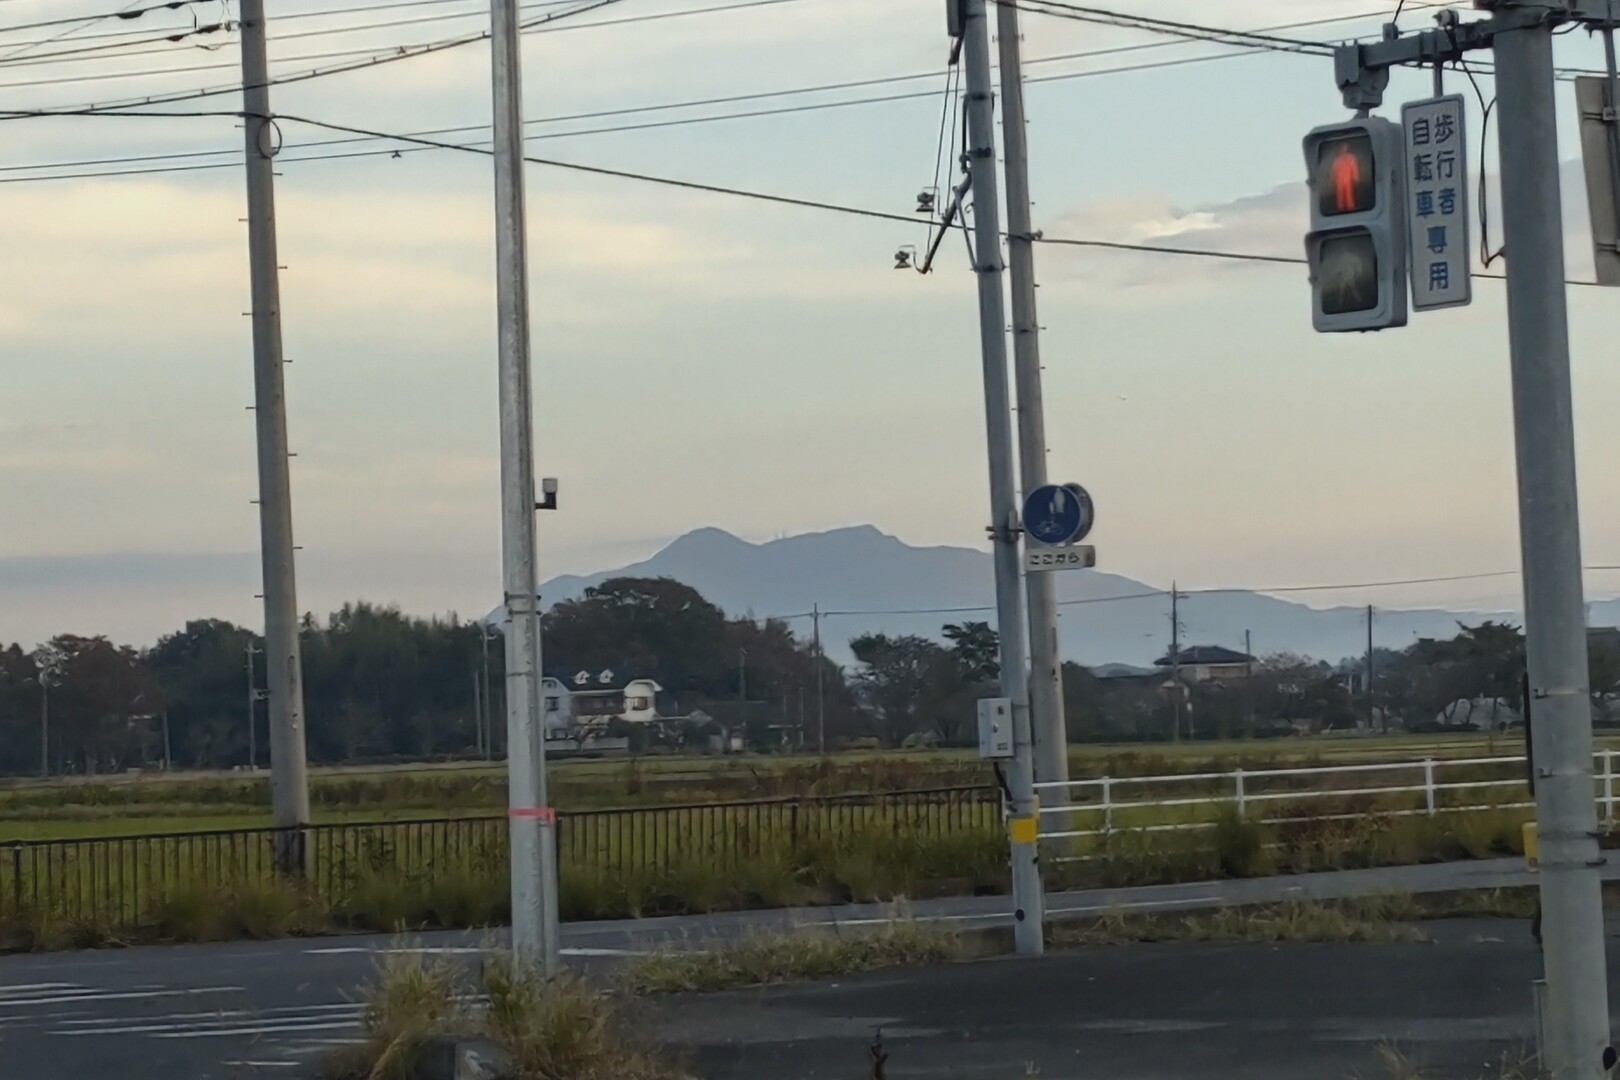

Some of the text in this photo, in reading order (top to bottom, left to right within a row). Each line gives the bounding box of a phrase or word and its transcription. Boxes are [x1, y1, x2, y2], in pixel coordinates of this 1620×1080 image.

[1412, 118, 1435, 219] 自転車
[1434, 114, 1456, 215] 歩行者
[1426, 225, 1448, 291] 専用
[1029, 552, 1080, 565] ここから
